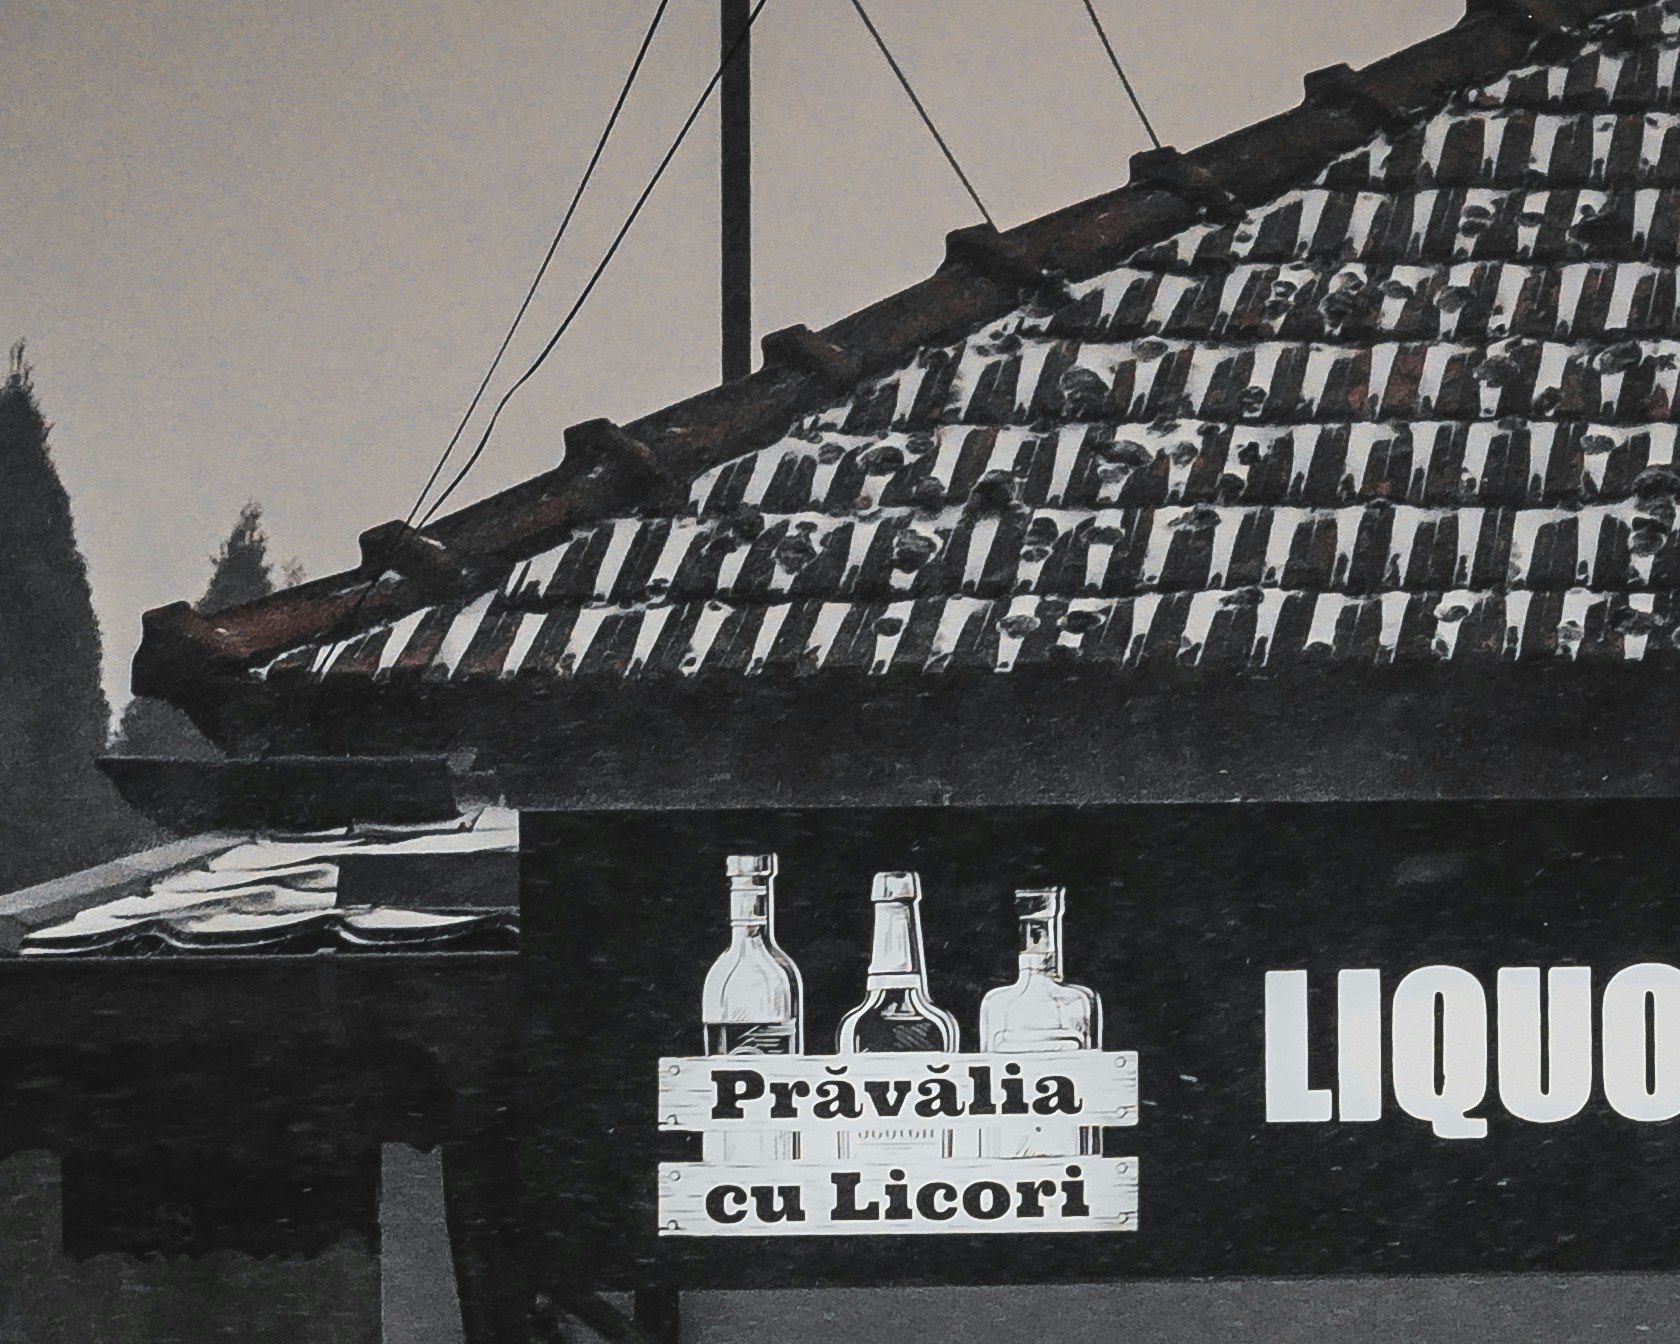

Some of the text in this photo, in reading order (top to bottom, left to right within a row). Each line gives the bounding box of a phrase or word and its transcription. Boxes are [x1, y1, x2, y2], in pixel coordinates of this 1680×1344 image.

[711, 1063, 1083, 1121] Prăvălia
[705, 1166, 1090, 1225] cu Licori
